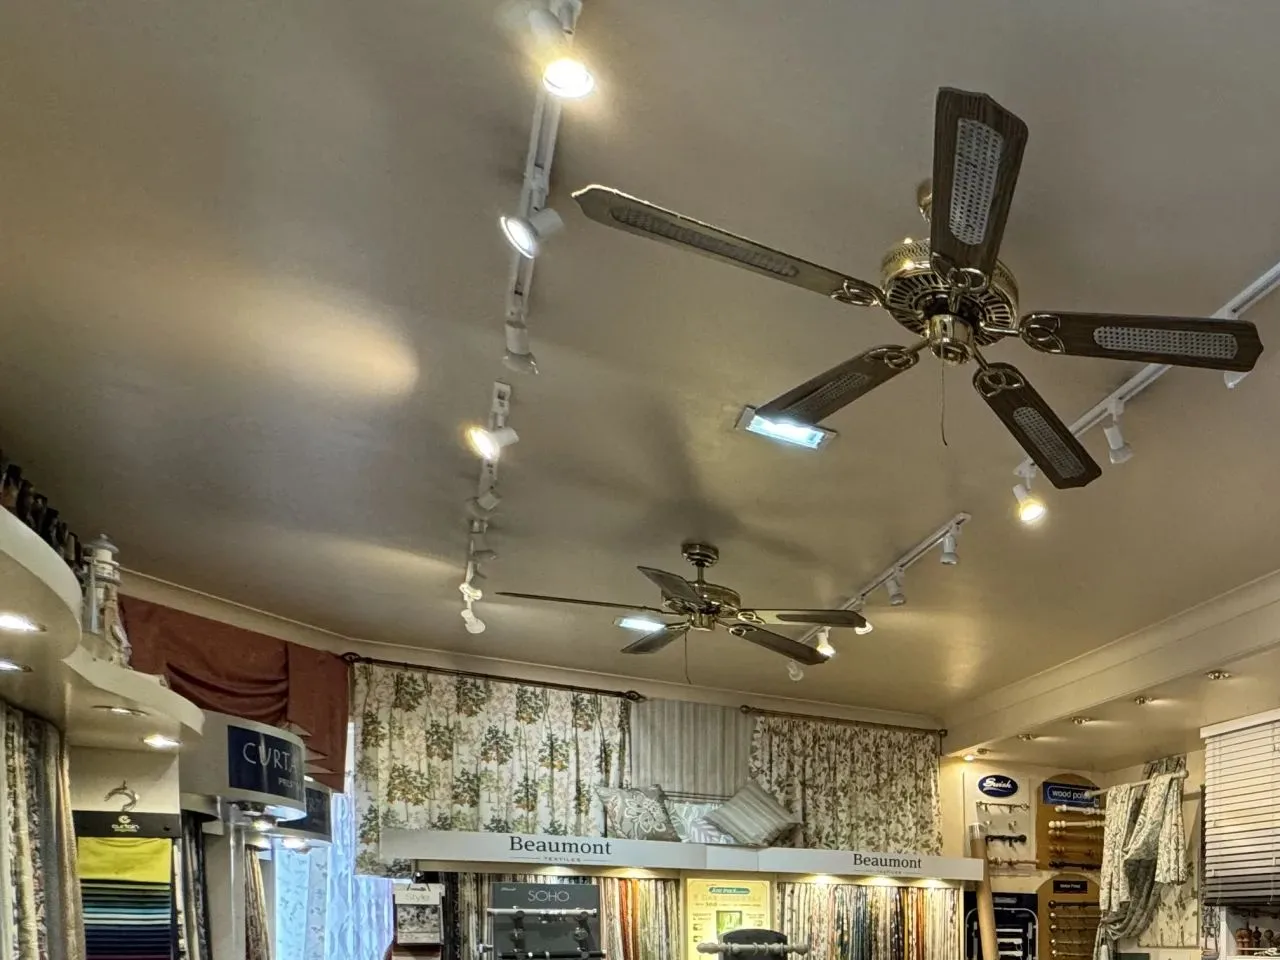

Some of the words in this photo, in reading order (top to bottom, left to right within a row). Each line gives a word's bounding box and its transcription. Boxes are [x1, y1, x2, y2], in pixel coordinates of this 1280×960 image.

[983, 778, 1012, 789] Swish
[1052, 788, 1072, 798] wood
[509, 836, 612, 855] Beaumont
[853, 853, 922, 869] Beaumont
[527, 890, 570, 902] SOHO
